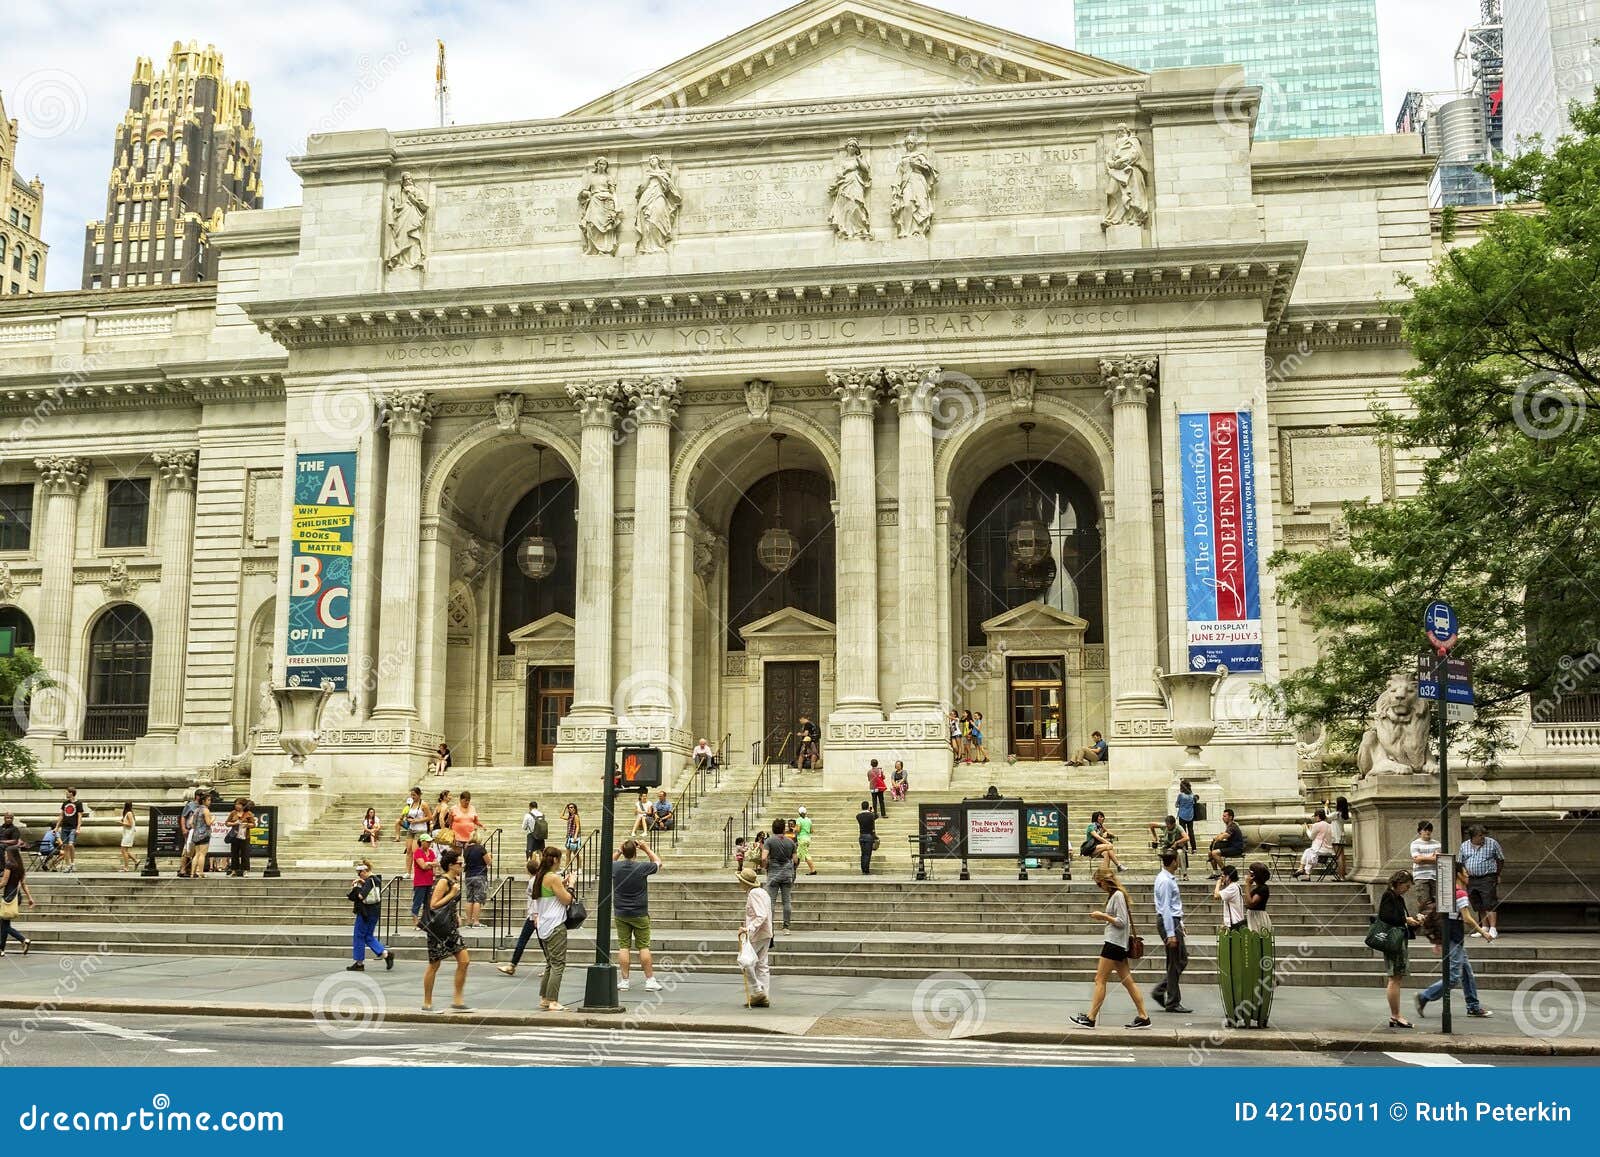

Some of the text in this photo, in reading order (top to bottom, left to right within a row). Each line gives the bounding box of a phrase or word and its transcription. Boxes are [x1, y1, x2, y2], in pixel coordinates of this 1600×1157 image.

[944, 149, 1087, 167] THE TILDEN TRUST
[769, 166, 824, 180] LIBRARY
[385, 310, 1137, 361] MDCCCXCV THE NEW YORK PUBLIC LIBRARY MDCCCCII
[1242, 420, 1250, 450] LIBRARY
[299, 460, 324, 472] THE
[316, 465, 351, 505] A
[1189, 420, 1210, 576] The Declaration of
[298, 507, 318, 515] WHY
[296, 518, 347, 528] CHILDREN'S
[300, 531, 330, 540] BOOKS
[1248, 536, 1254, 546] AT
[292, 556, 322, 596] B
[316, 588, 348, 628] C
[290, 628, 325, 640] OF IT
[1192, 633, 1214, 642] JUNE
[306, 656, 346, 664] EXHIBITION
[1420, 686, 1436, 696] Q32
[1028, 812, 1058, 826] ABC
[992, 826, 1014, 834] Library
